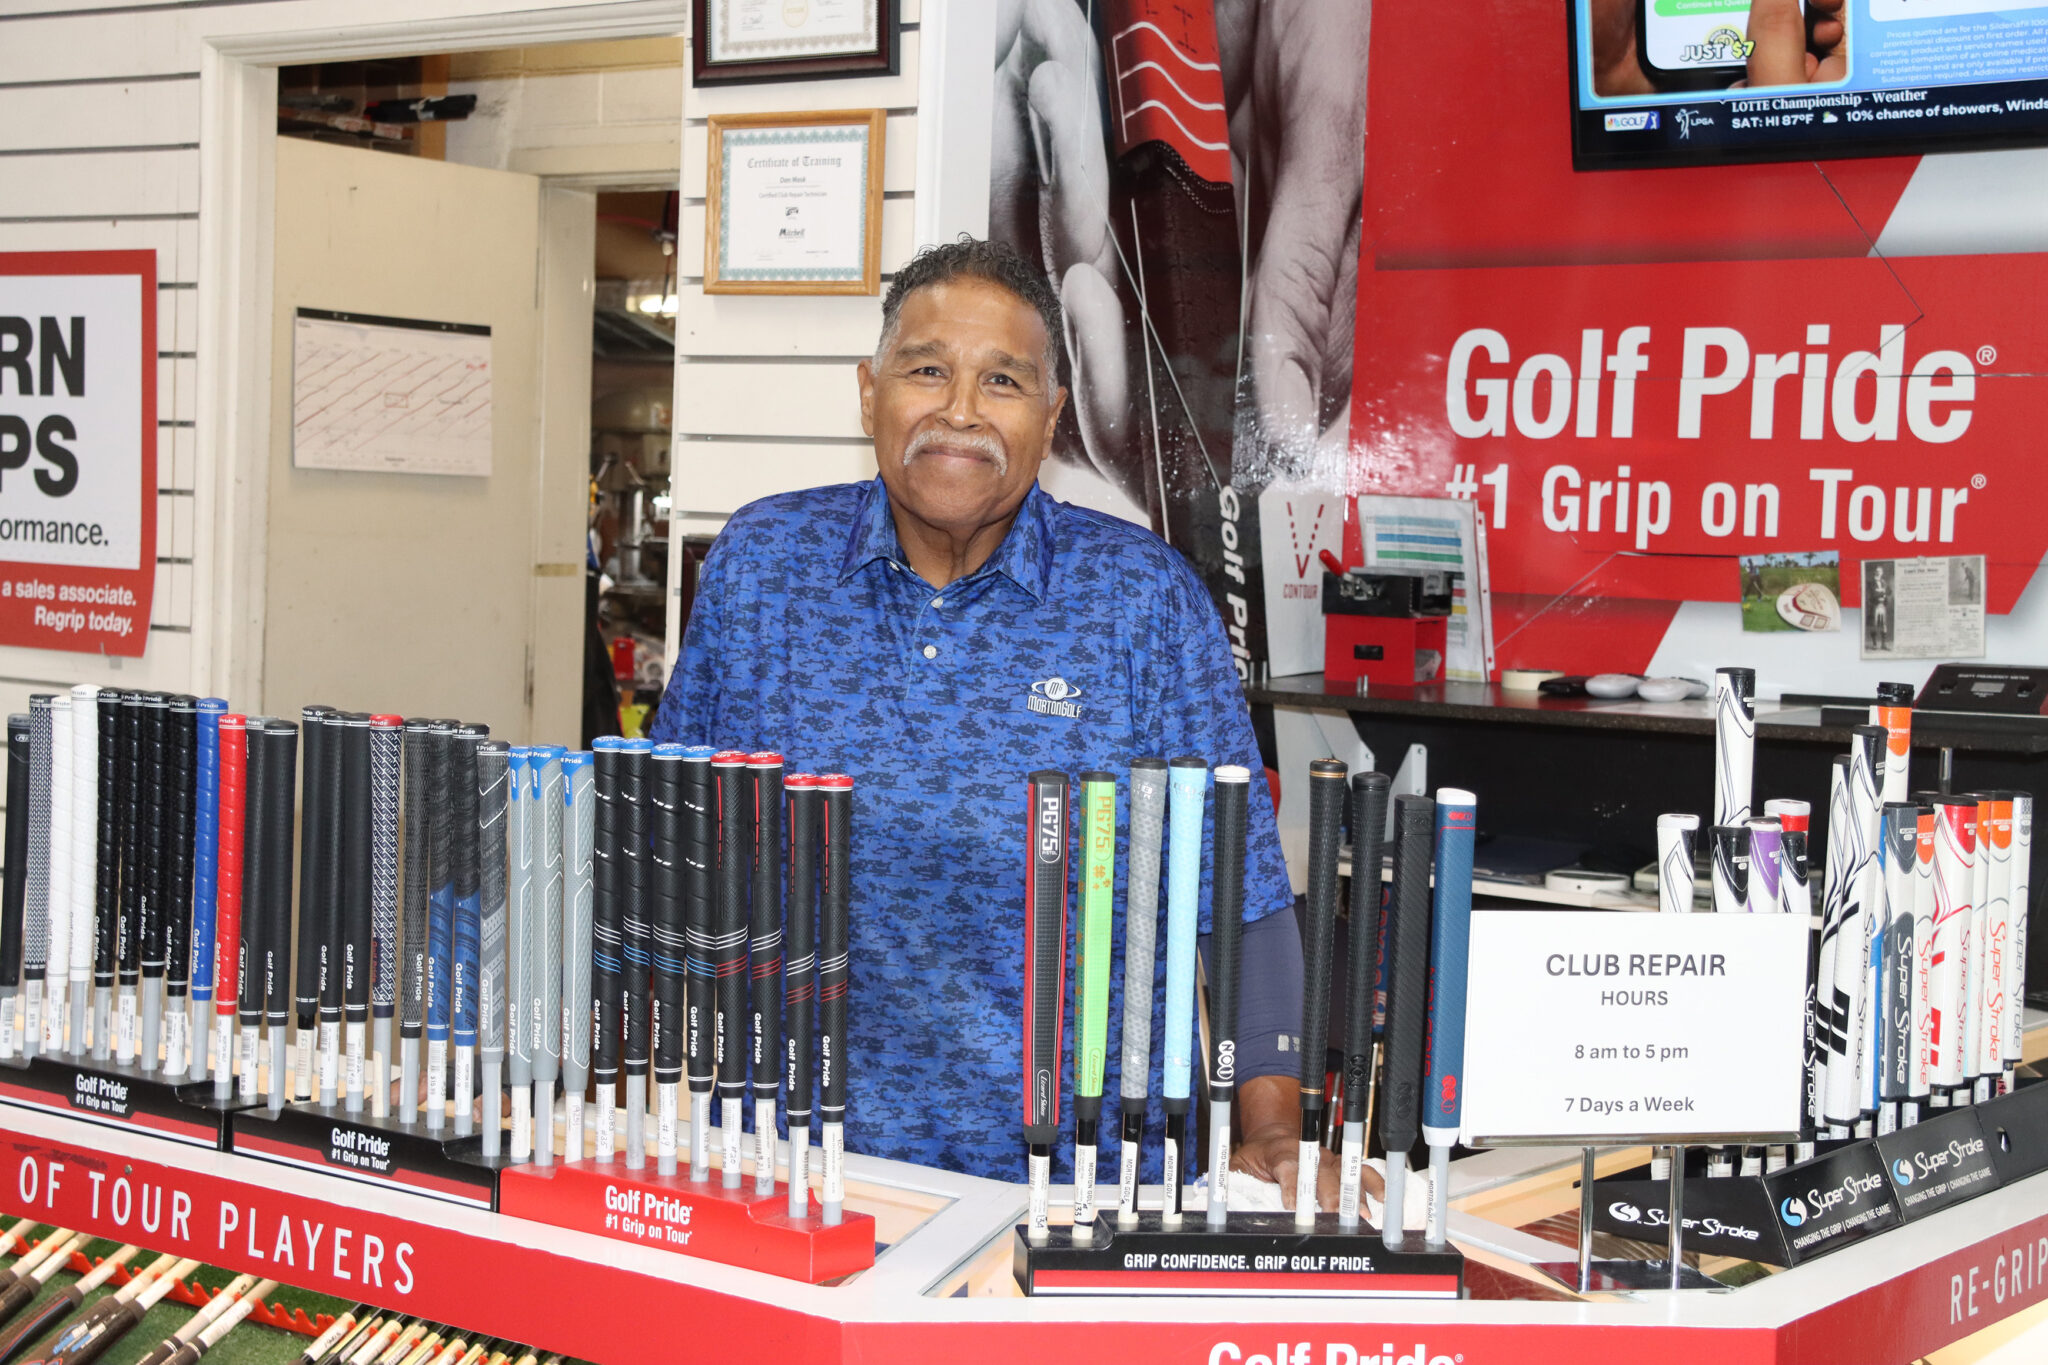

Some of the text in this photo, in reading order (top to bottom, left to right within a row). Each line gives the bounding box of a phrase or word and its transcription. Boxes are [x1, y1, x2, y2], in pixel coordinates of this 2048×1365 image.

[1680, 40, 1756, 62] JUST $7
[1732, 100, 1772, 113] LOTTE
[1772, 93, 1862, 111] Championship
[1873, 88, 1927, 104] Weather
[1620, 116, 1647, 127] GOLF
[1690, 117, 1715, 127] LPGA
[1732, 117, 1763, 129] SAT:
[1765, 116, 1779, 127] HI
[1846, 110, 1874, 122] 10%
[1876, 107, 1924, 120] chance
[1925, 105, 1940, 117] of
[1942, 102, 2004, 116] showers,
[747, 155, 842, 169] Certificate of Training
[1445, 326, 1651, 440] Golf
[1445, 463, 1509, 530] #1
[1541, 465, 1671, 550] Grip
[1701, 481, 1780, 538] on
[1219, 485, 1246, 585] Golf
[2, 580, 137, 607] a sales associate.
[1283, 583, 1319, 600] CONTOUR
[35, 606, 134, 635] Regrip today.
[1041, 797, 1059, 850] PG75
[1095, 796, 1113, 849] PG75
[346, 944, 354, 963] Golf
[1545, 953, 1727, 977] CLUB REPAIR
[415, 954, 424, 1001] Golf Pride
[455, 963, 463, 1014] Golf Pride
[653, 1000, 661, 1023] Golf
[1601, 990, 1669, 1007] HOURS
[690, 1007, 698, 1058] Golf Pride
[717, 1012, 725, 1064] Golf Pride
[754, 1012, 763, 1064] Golf Pride
[788, 1039, 796, 1091] Golf Pride
[822, 1036, 831, 1088] Golf Pride
[1574, 1044, 1689, 1063] 8 am to 5 pm
[75, 1073, 98, 1094] Golf
[1040, 1075, 1048, 1099] Lizard
[76, 1092, 84, 1105] #1
[86, 1095, 100, 1110] Grip
[102, 1099, 111, 1110] on
[1565, 1096, 1695, 1116] 7 Days a Week
[332, 1127, 356, 1149] Golf
[331, 1147, 341, 1160] #1
[343, 1150, 359, 1166] Grip
[360, 1156, 370, 1167] on
[605, 1185, 641, 1214] Golf
[1904, 1166, 1992, 1207] CHANGING THE GRIP CHANGING THE GAME
[19, 1155, 414, 1295] OF TOUR PLAYERS
[605, 1213, 618, 1230] #1
[622, 1217, 646, 1238] Grip
[648, 1225, 663, 1239] on
[1644, 1208, 1700, 1229] Suer
[1793, 1203, 1892, 1249] CHANGING THE GRIP CHANGING THE GAME
[1124, 1253, 1374, 1271] GRIP CONFIDENCE. GRIP GOLF PRIDE.
